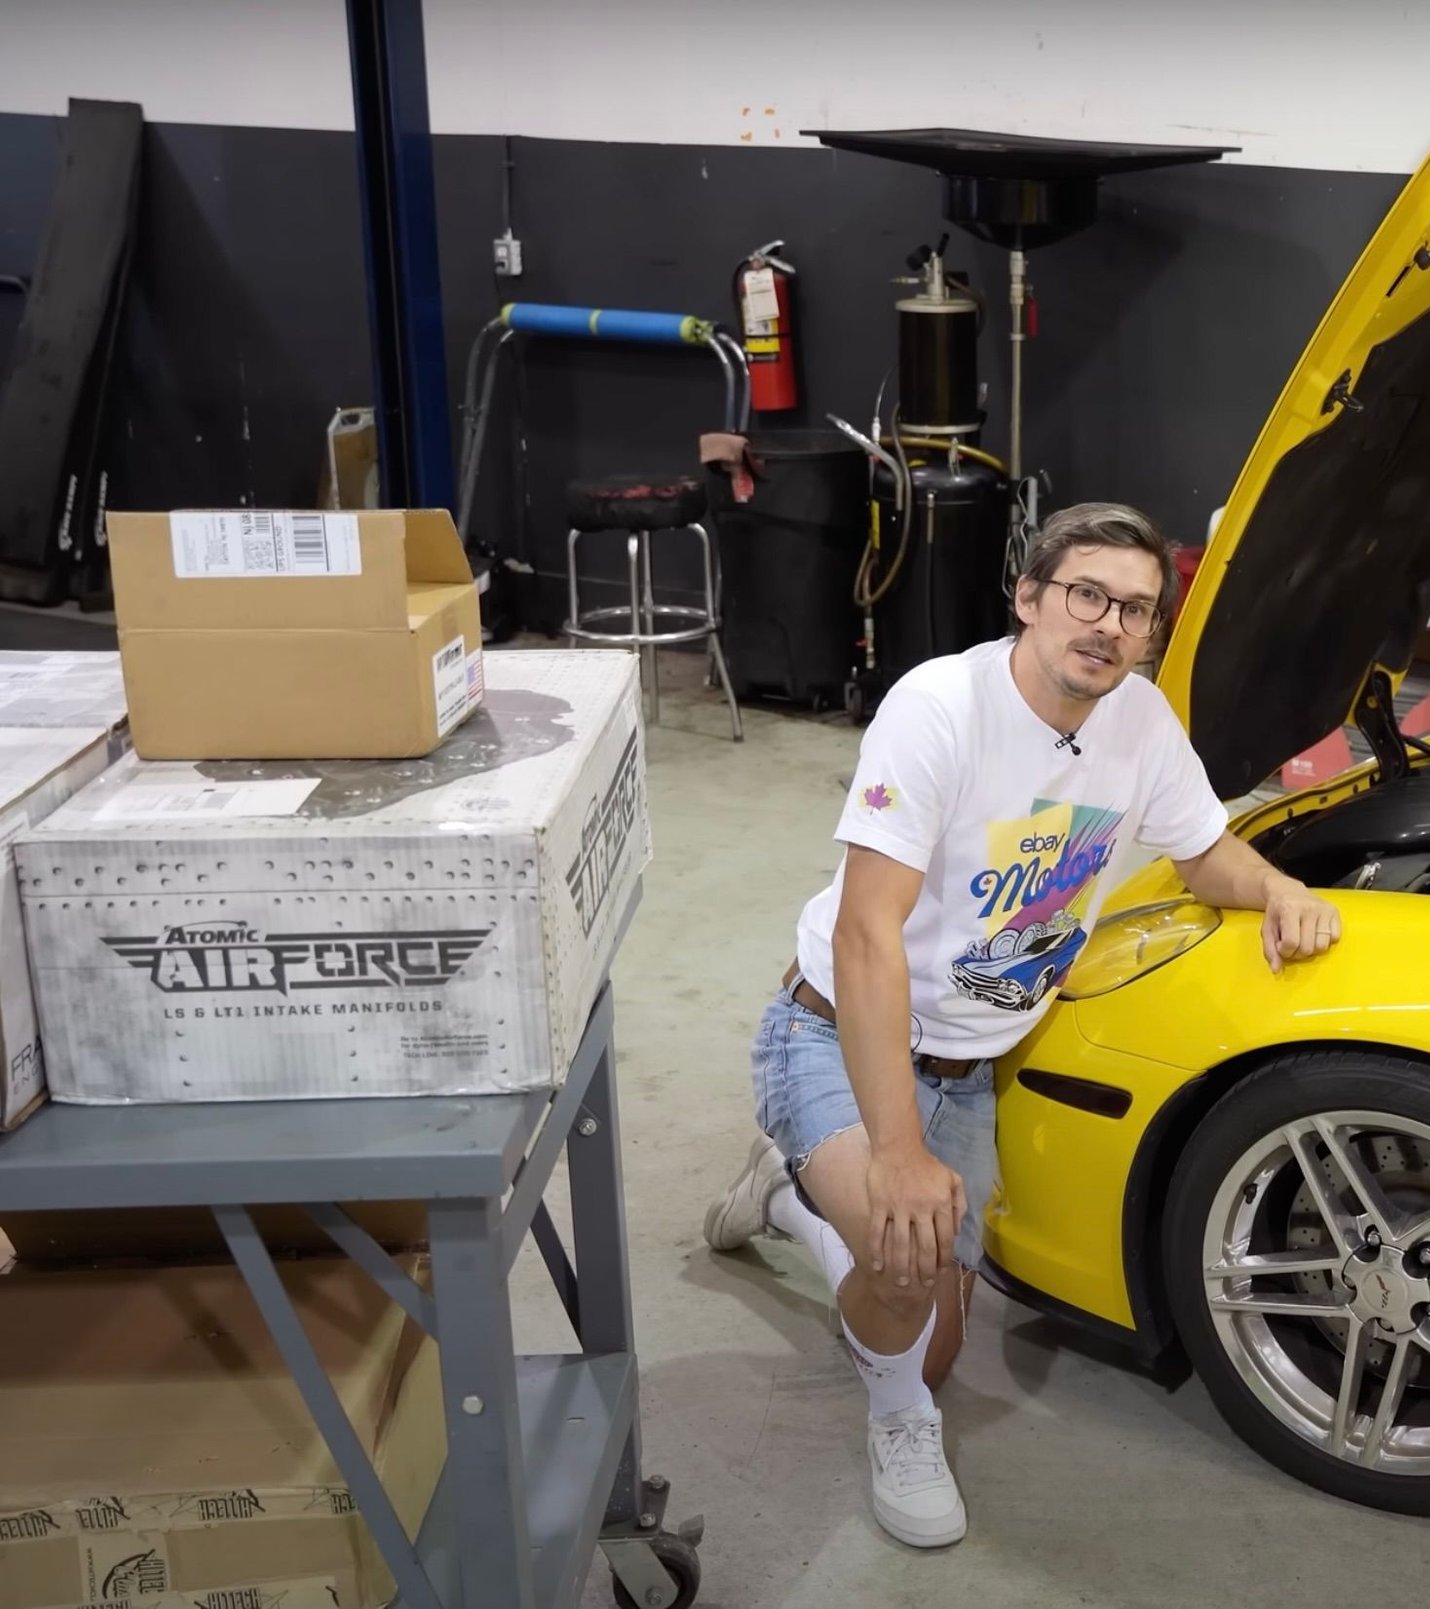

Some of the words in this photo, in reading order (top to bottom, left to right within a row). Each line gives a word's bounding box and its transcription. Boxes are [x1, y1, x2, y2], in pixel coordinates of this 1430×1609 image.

[1019, 832, 1066, 853] ebay
[164, 925, 260, 945] ATOMIC
[163, 1008, 186, 1019] LS
[214, 1006, 244, 1018] LT1
[253, 1004, 324, 1017] INTAKE
[332, 1001, 443, 1015] MANIFOLDS
